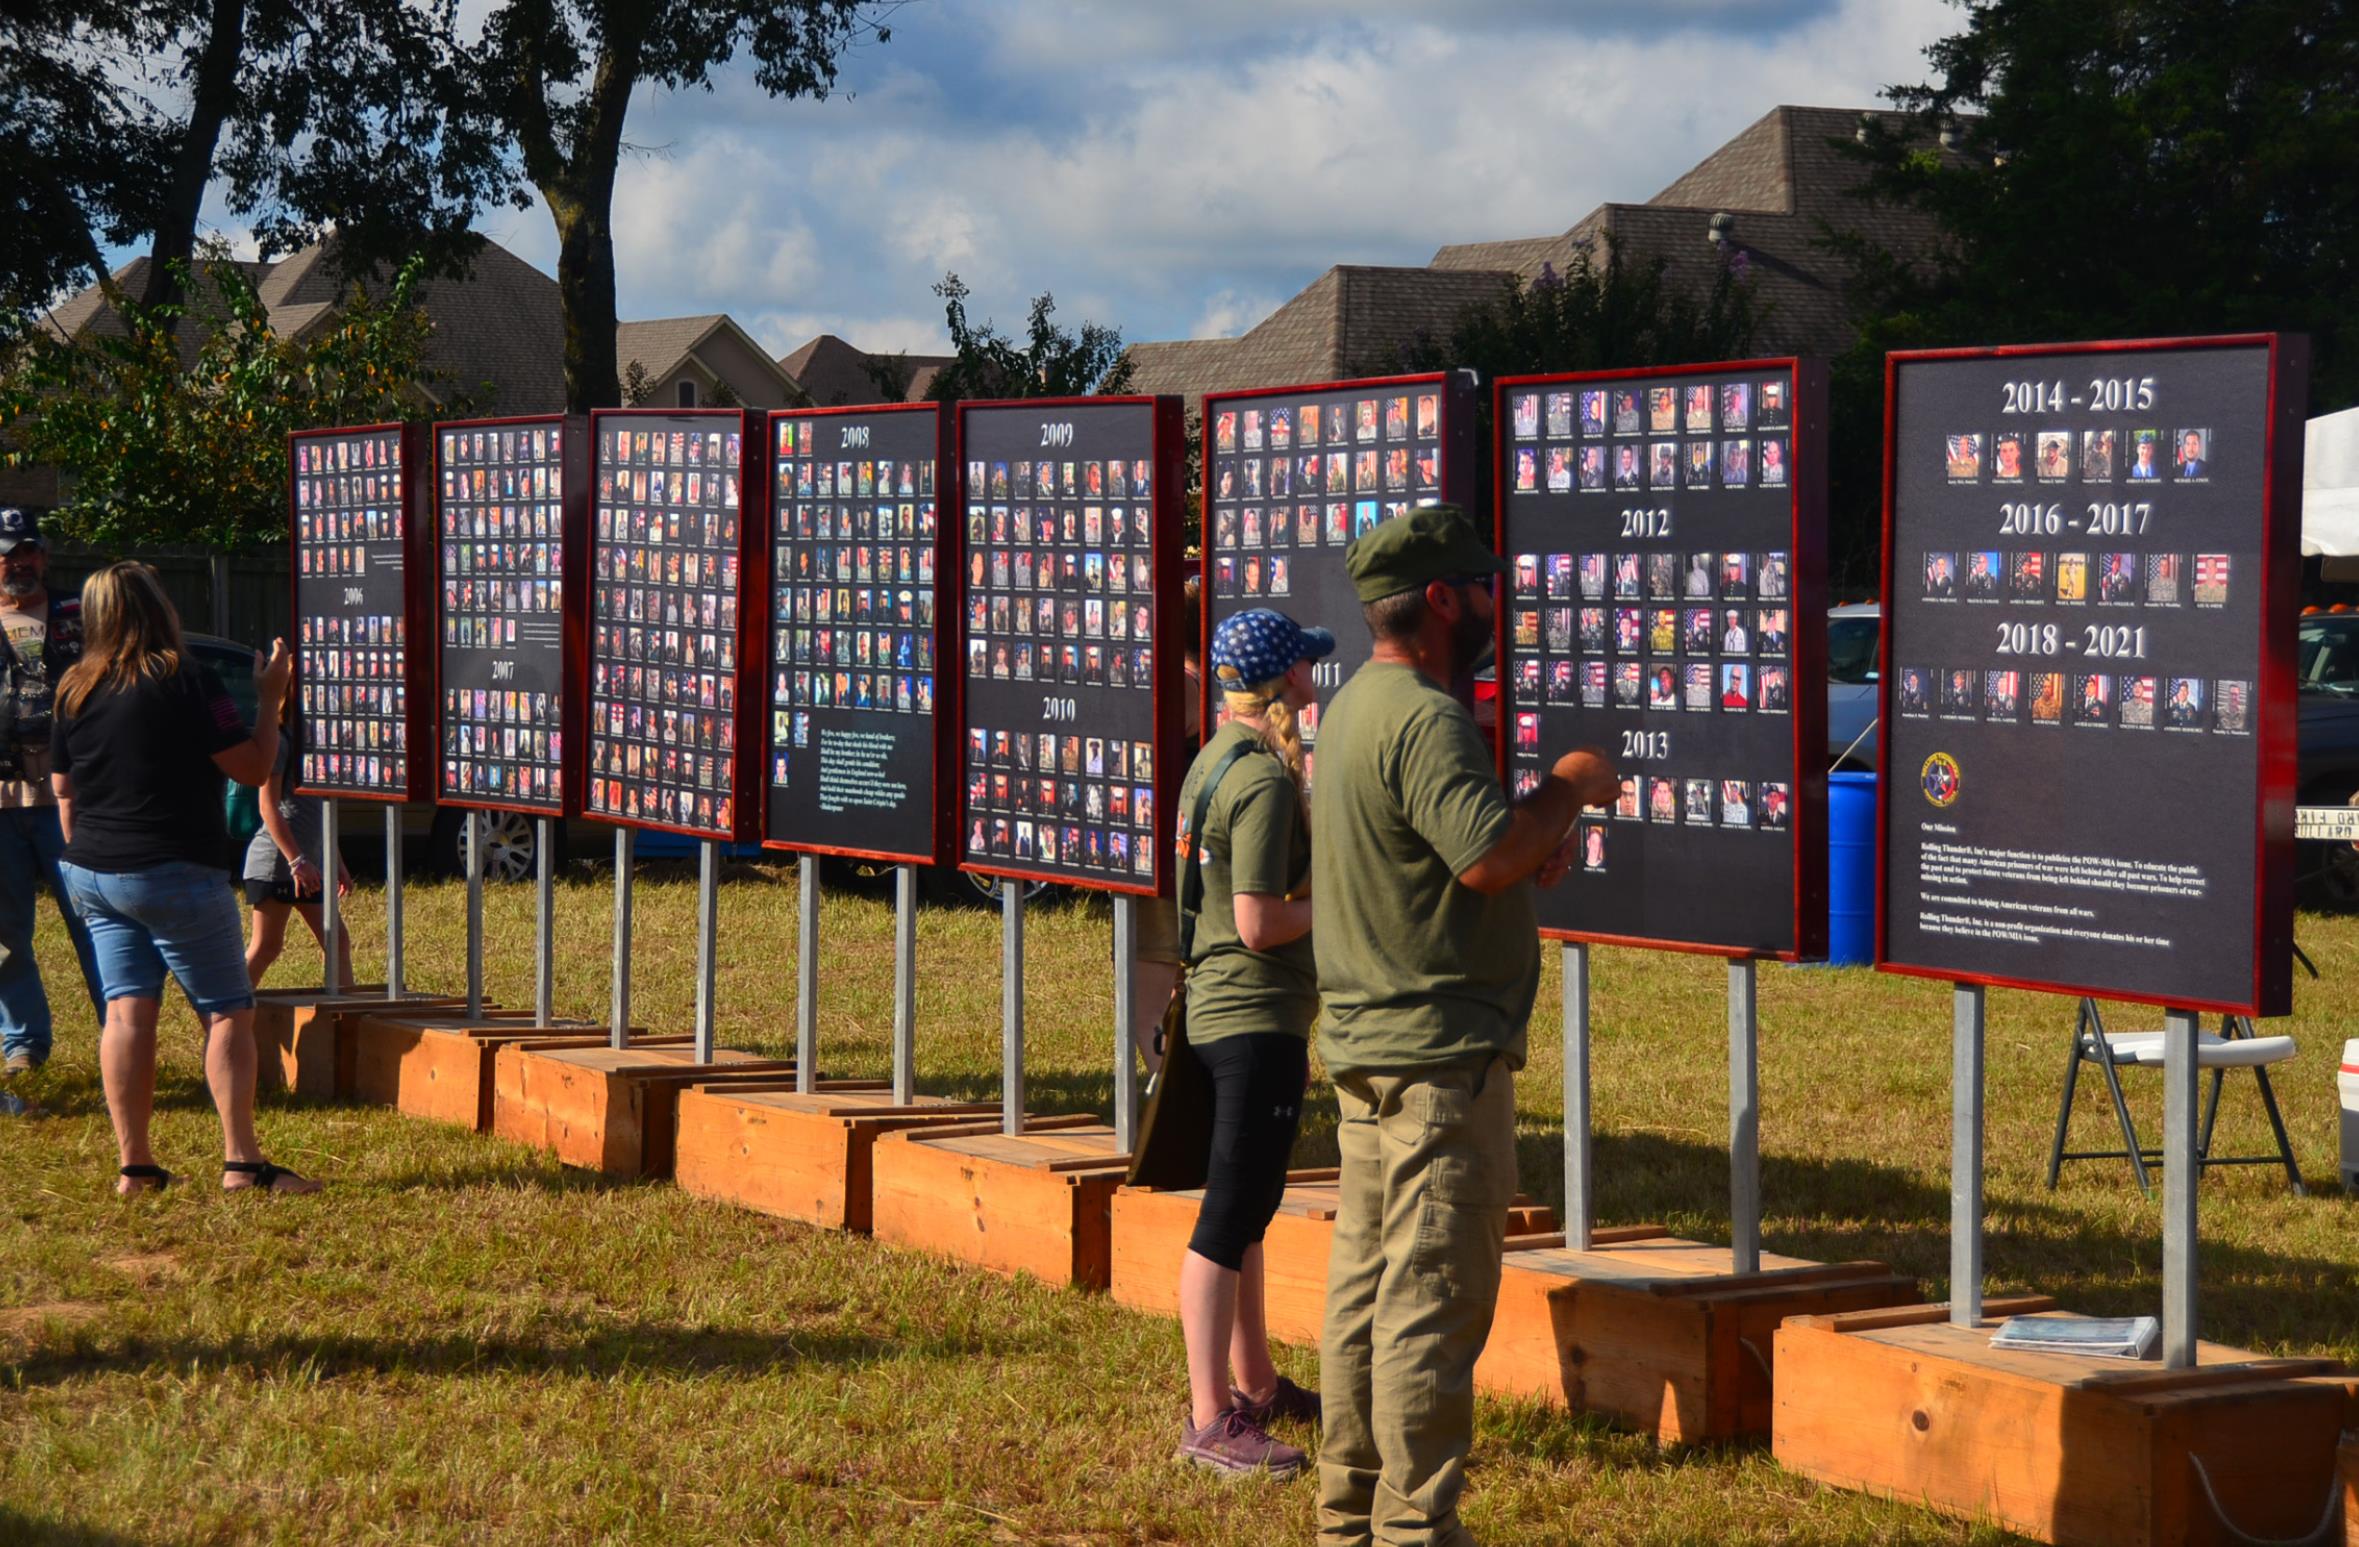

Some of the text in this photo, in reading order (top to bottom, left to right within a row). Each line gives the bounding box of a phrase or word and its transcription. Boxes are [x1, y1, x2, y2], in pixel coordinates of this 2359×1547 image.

[2001, 381, 2063, 413] 2014
[2089, 378, 2155, 411] 2015
[840, 425, 870, 449] 2008
[1039, 422, 1073, 446] 2009
[1620, 509, 1670, 537] 2012
[1999, 503, 2062, 535] 2016
[2086, 502, 2150, 535] 2017
[1995, 623, 2058, 656] 2018
[2084, 625, 2146, 657] 2021
[491, 660, 514, 680] 2007
[1312, 661, 1341, 688] 011
[1042, 697, 1076, 722] 2010
[1622, 730, 1669, 759] 2013
